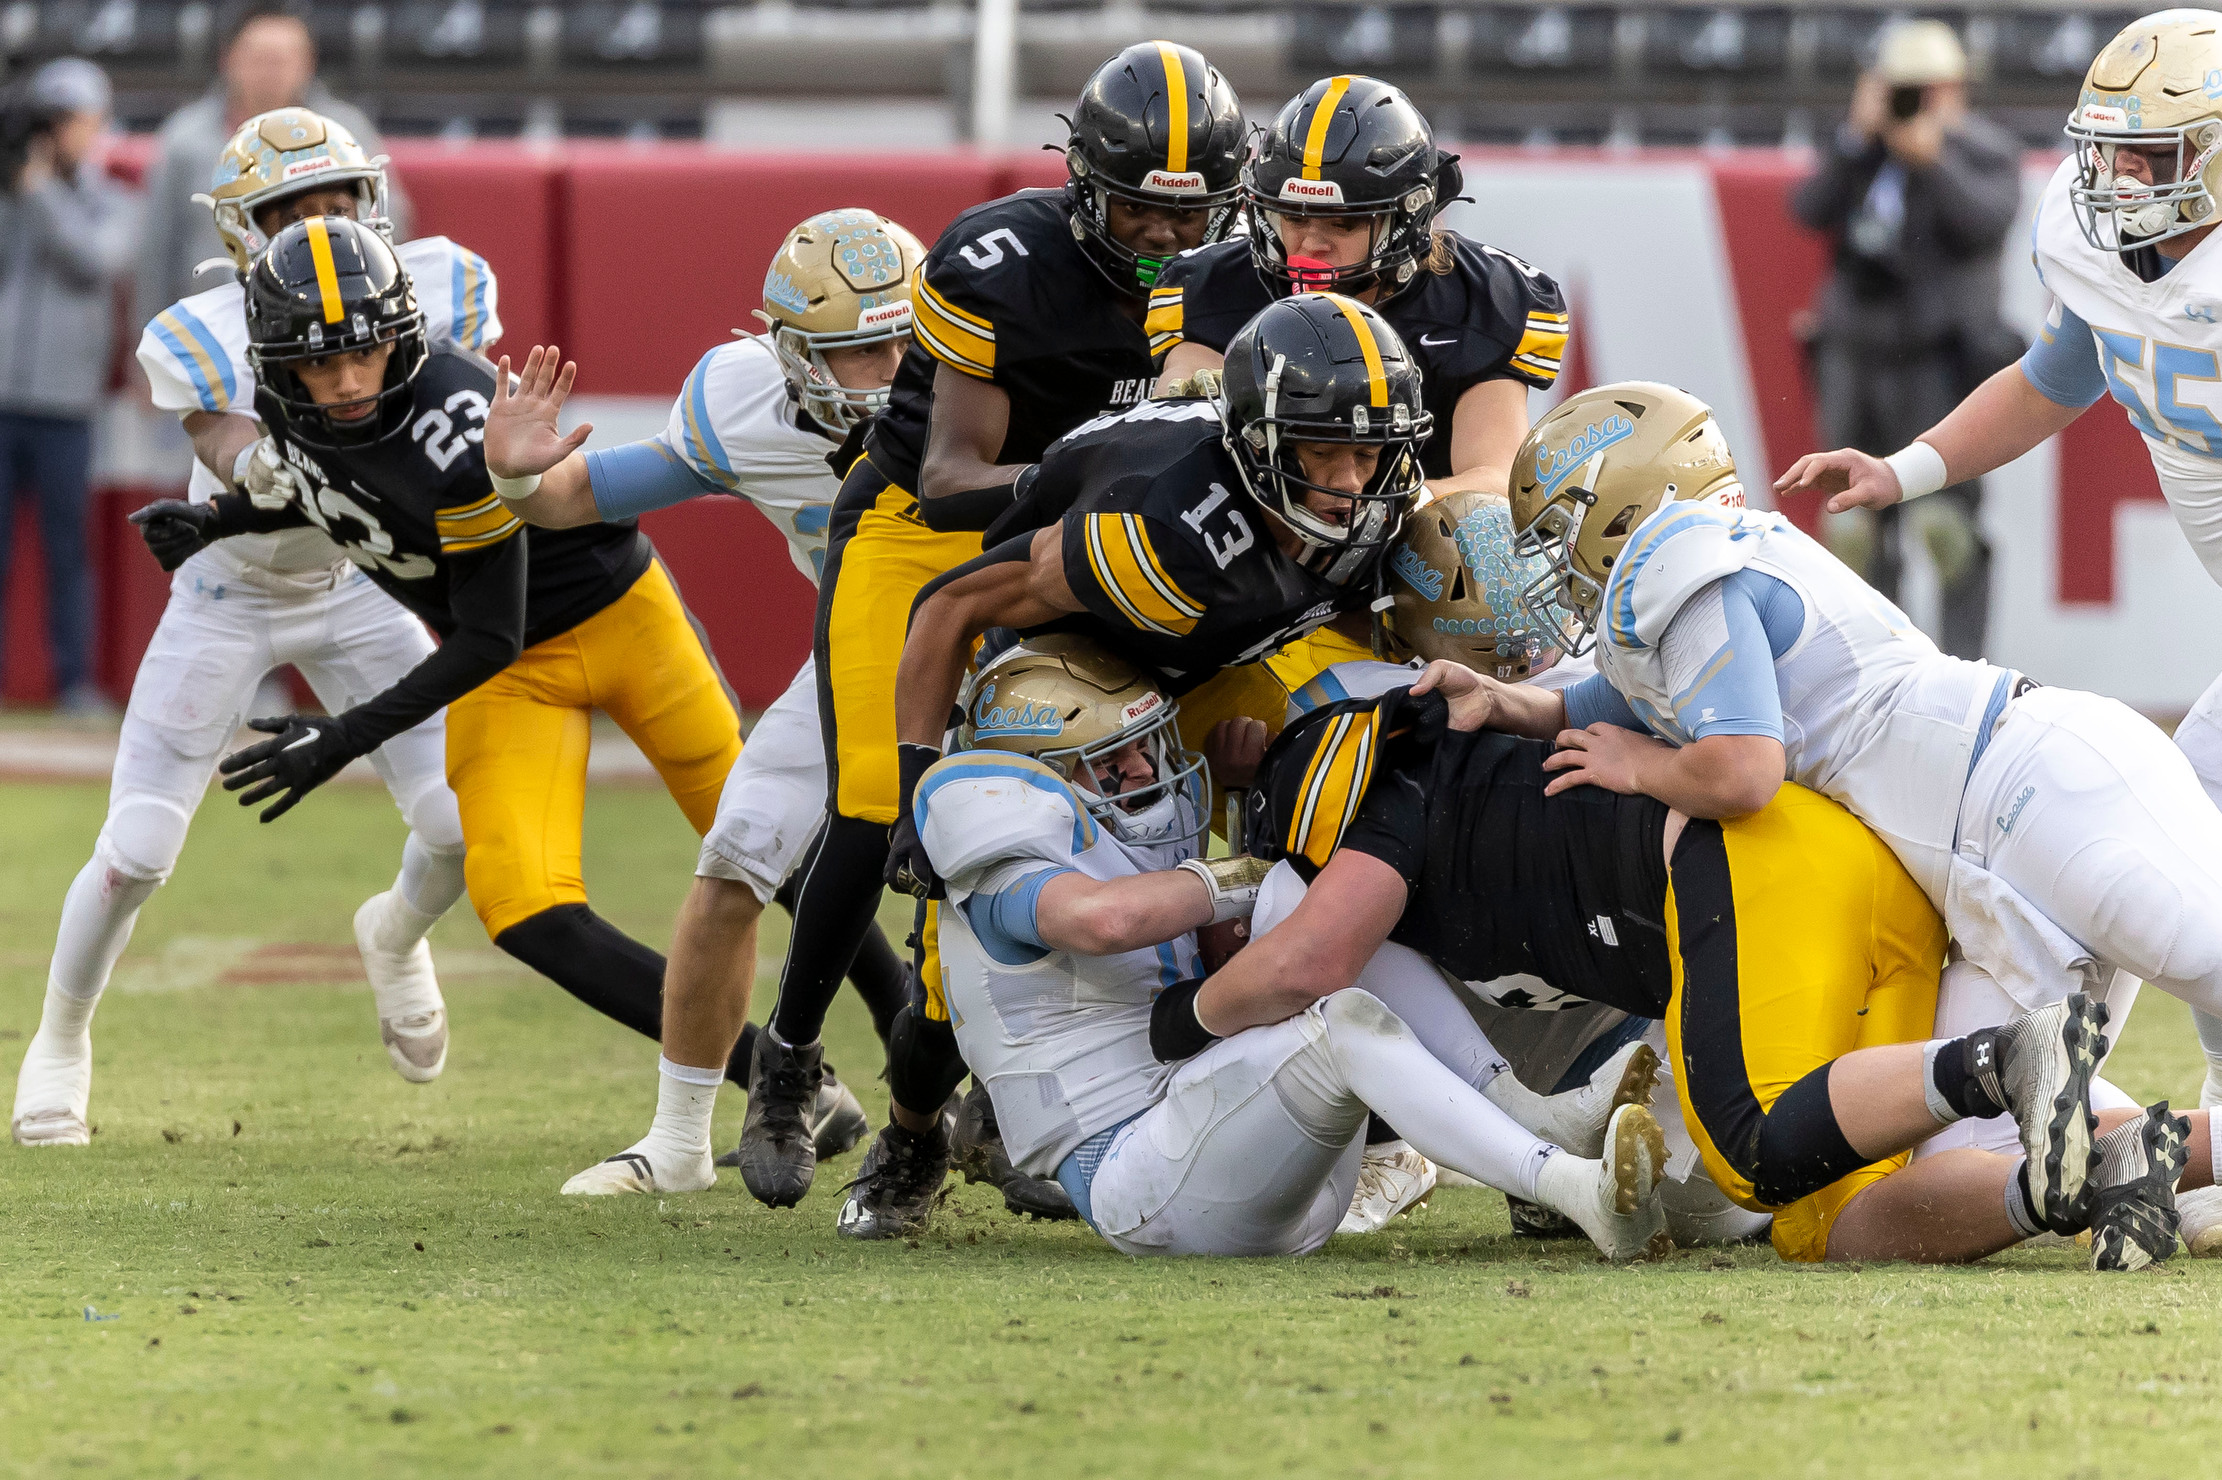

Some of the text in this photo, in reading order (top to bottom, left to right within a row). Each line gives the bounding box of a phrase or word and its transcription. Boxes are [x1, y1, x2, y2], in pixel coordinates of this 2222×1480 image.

[1152, 175, 1199, 188] Riddell
[1287, 182, 1334, 197] Riddell
[959, 228, 1029, 270] 5
[2090, 324, 2222, 460] 55
[412, 389, 490, 472] 23
[1535, 414, 1634, 499] Coosa
[1180, 482, 1254, 570] 13
[974, 683, 1064, 742] Coosa
[1996, 786, 2036, 838] Coosa
[1587, 919, 1599, 938] XL
